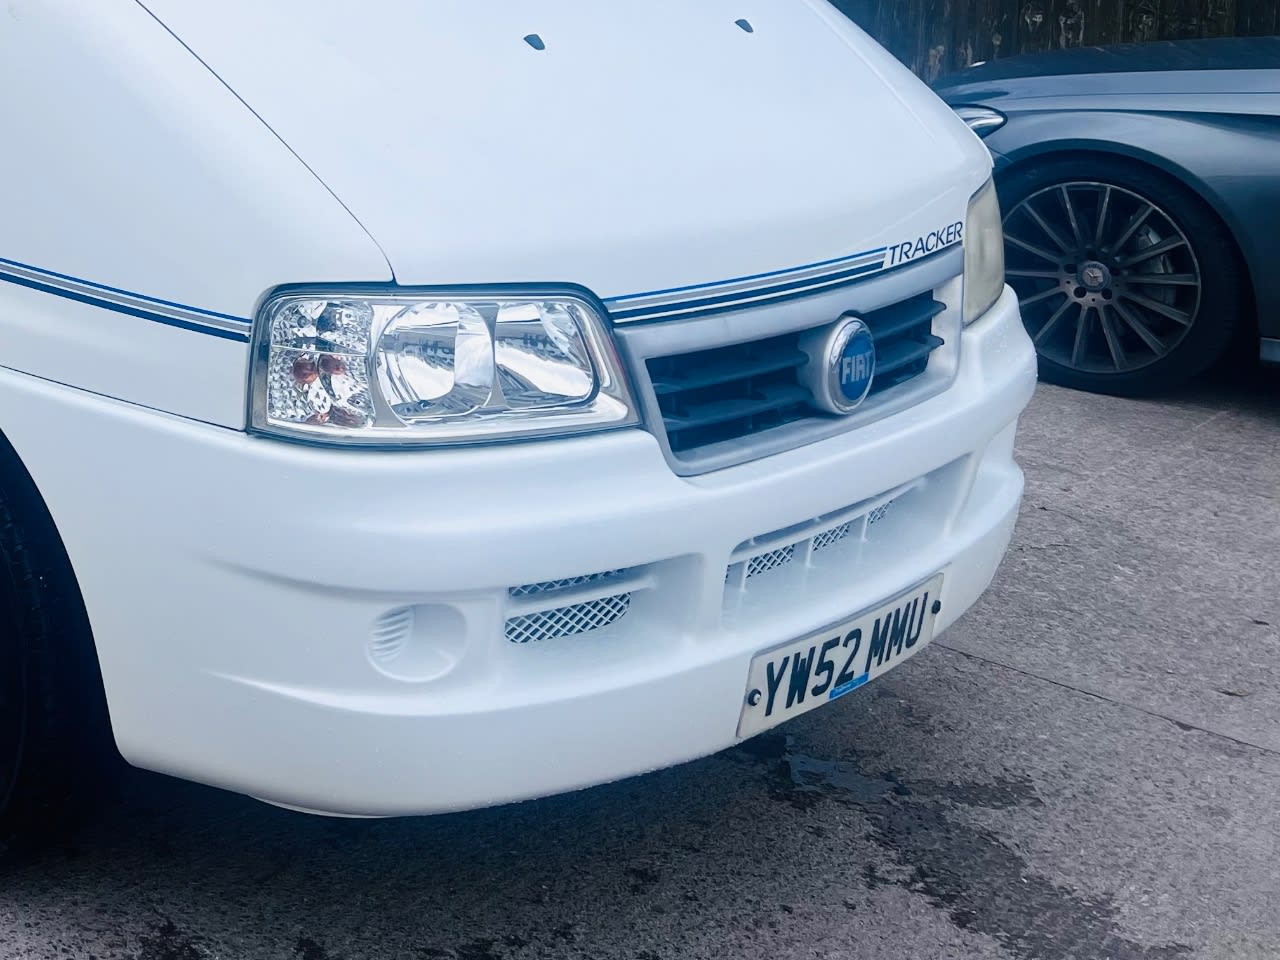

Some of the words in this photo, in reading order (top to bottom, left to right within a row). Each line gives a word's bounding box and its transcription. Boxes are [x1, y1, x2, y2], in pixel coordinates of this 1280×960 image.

[889, 221, 963, 265] TRACKER
[841, 350, 873, 384] FIAT
[765, 628, 862, 717] YW52
[865, 592, 928, 672] MMU
